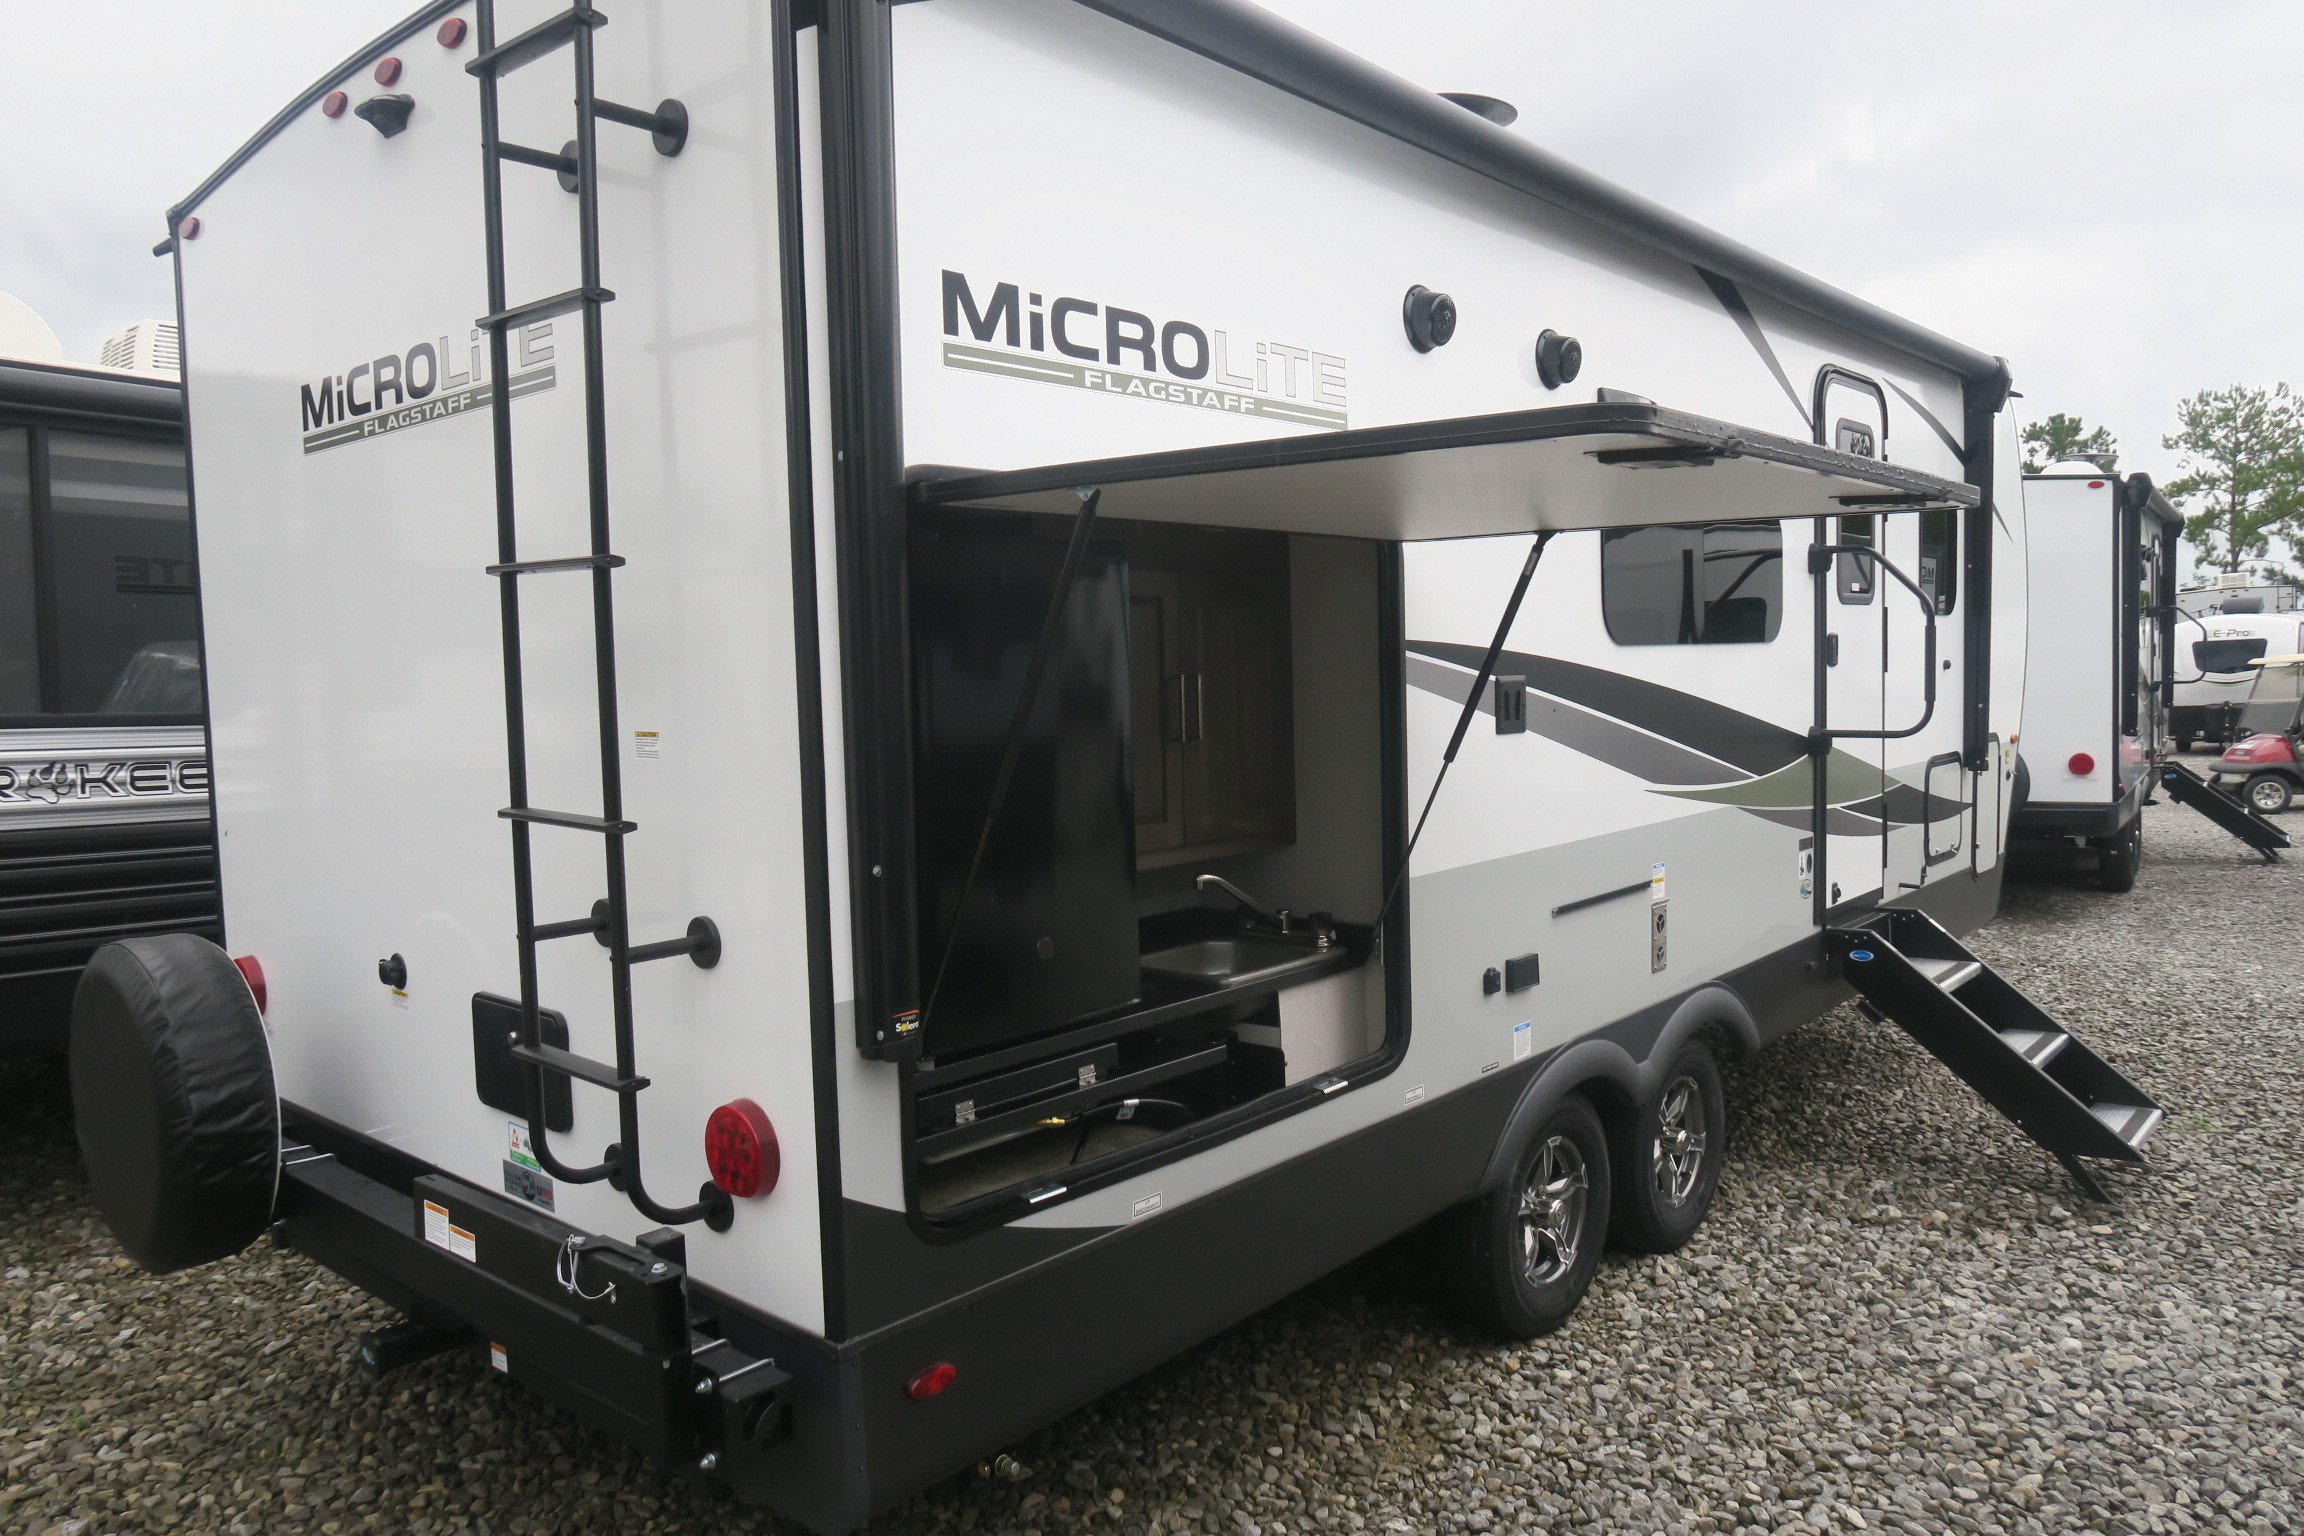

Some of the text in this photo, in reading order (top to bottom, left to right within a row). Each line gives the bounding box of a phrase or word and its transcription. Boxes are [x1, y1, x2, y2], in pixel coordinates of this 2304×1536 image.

[300, 322, 555, 432] MiCROLiE
[1084, 369, 1256, 414] FLAGSTAFF
[363, 391, 471, 437] FLAGSTAFF
[2213, 629, 2250, 638] E-Pro
